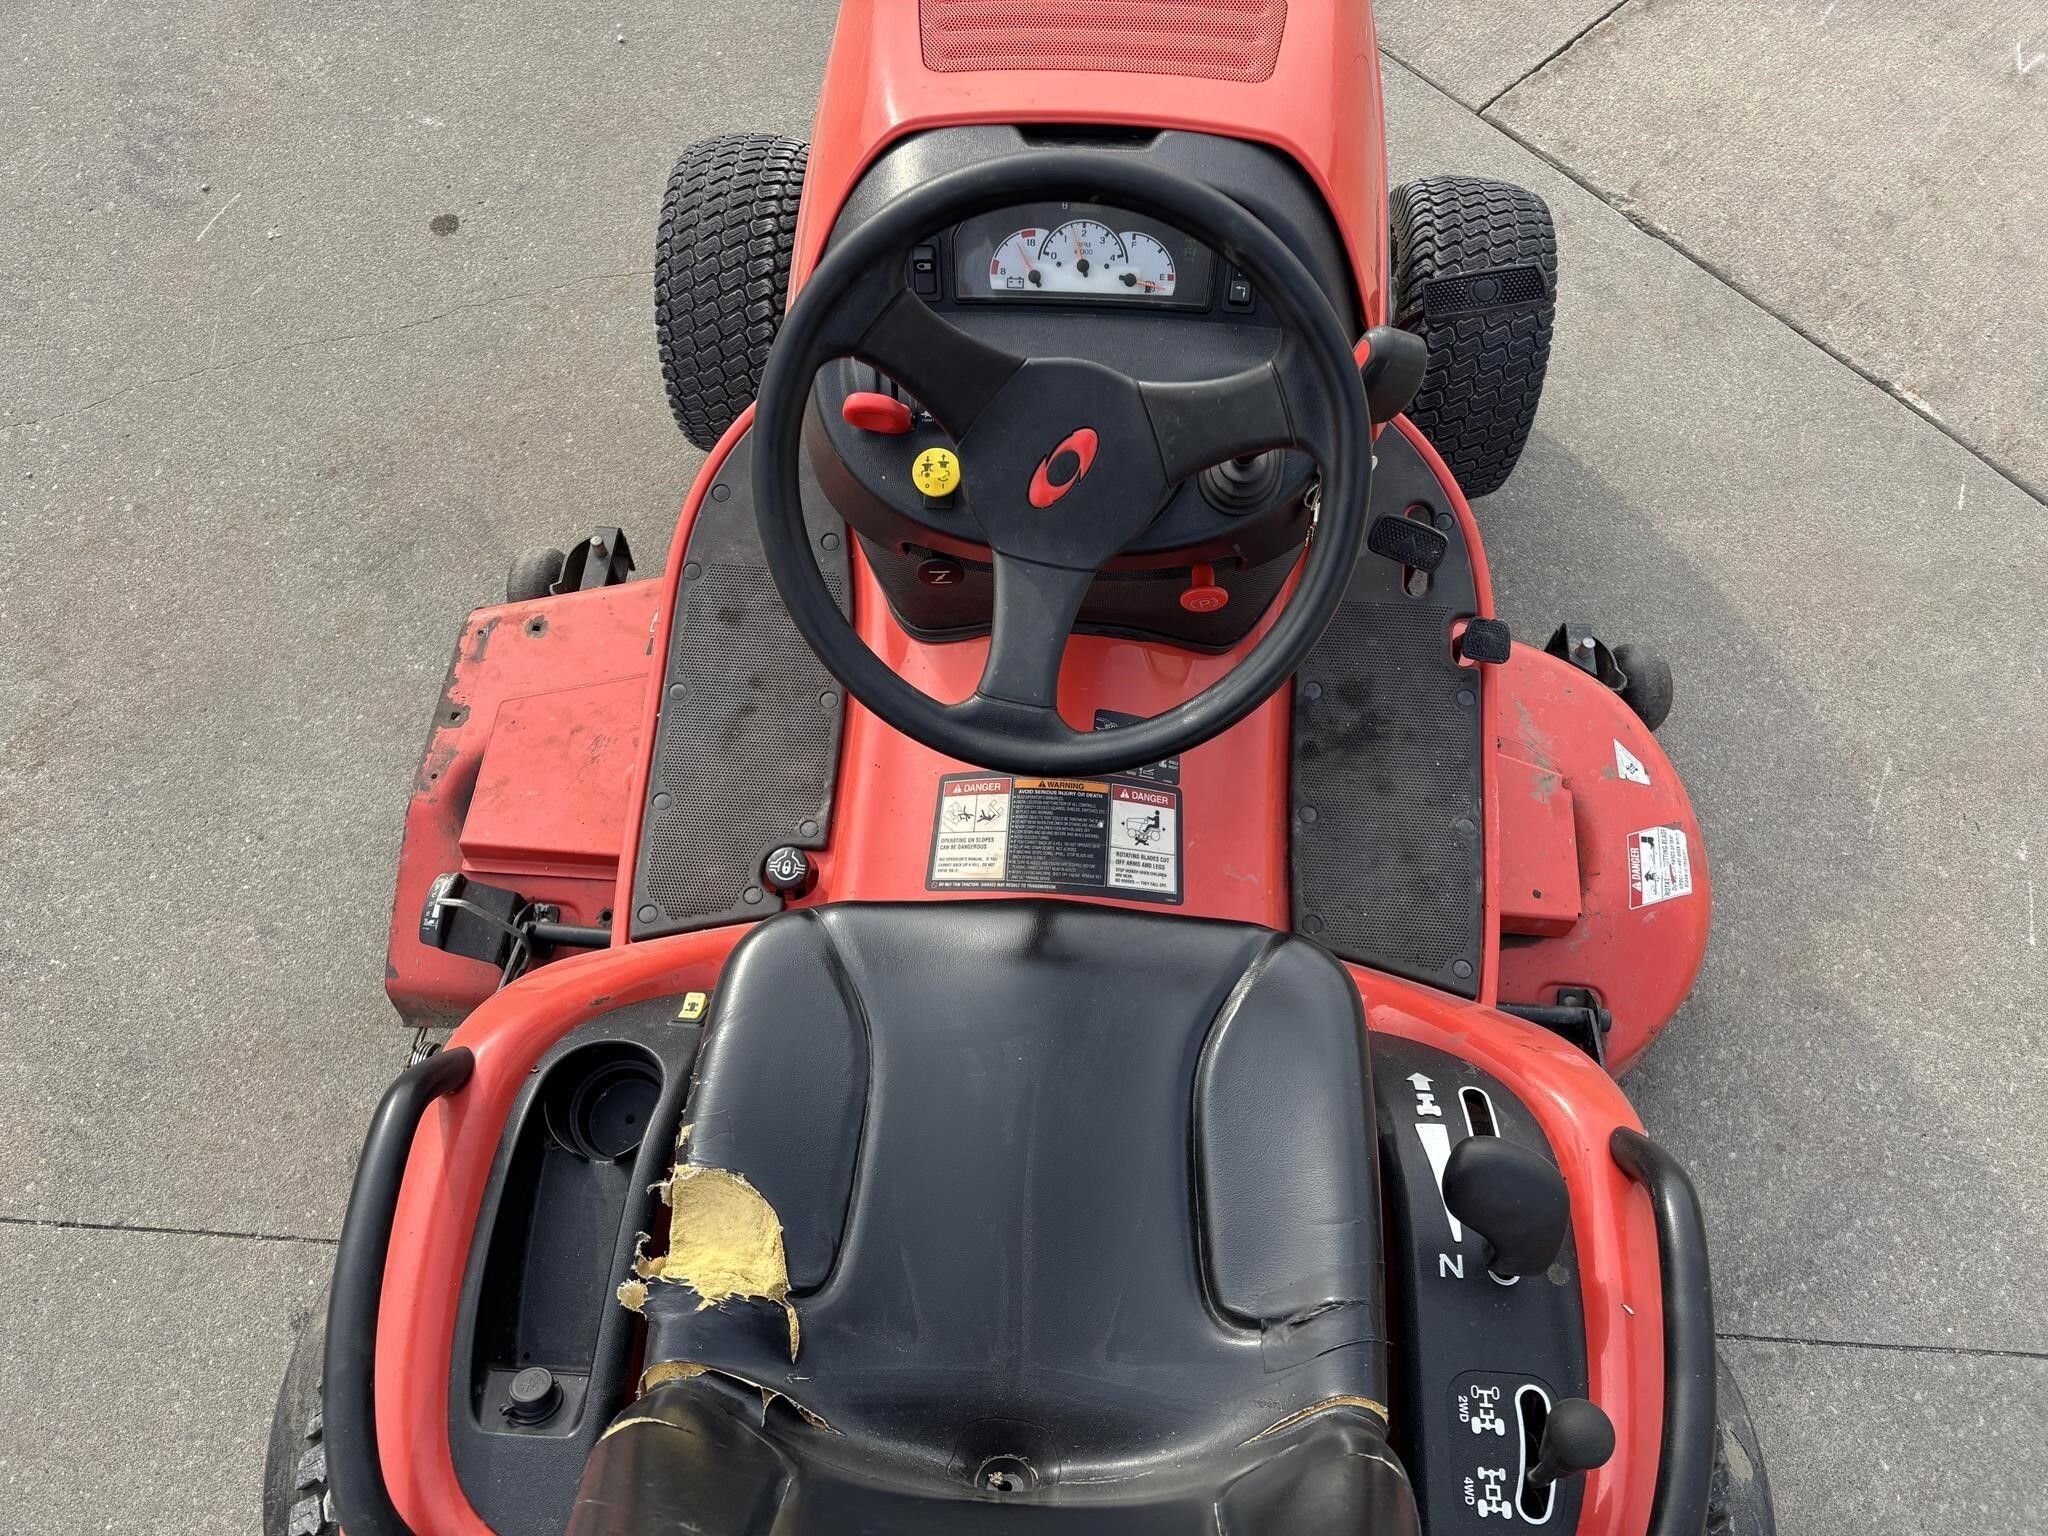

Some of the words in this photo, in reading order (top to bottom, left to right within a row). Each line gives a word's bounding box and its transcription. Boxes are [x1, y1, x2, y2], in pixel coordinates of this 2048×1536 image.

[1081, 229, 1088, 238] 2
[1026, 238, 1036, 248] 18
[1099, 236, 1106, 245] 3
[1131, 240, 1137, 249] F
[1050, 251, 1057, 260] 0
[1109, 254, 1116, 262] 4
[1000, 267, 1006, 275] 8
[1159, 273, 1165, 281] E
[963, 782, 1002, 793] DANGER
[1047, 781, 1085, 790] WARNING
[1131, 791, 1169, 806] DANGER
[1115, 851, 1140, 860] ROTATING
[1140, 854, 1159, 862] BLADES
[1631, 847, 1642, 880] DANGER
[1438, 1253, 1464, 1279] N
[1457, 1394, 1469, 1424] 2WD
[1463, 1476, 1475, 1506] 4WD
